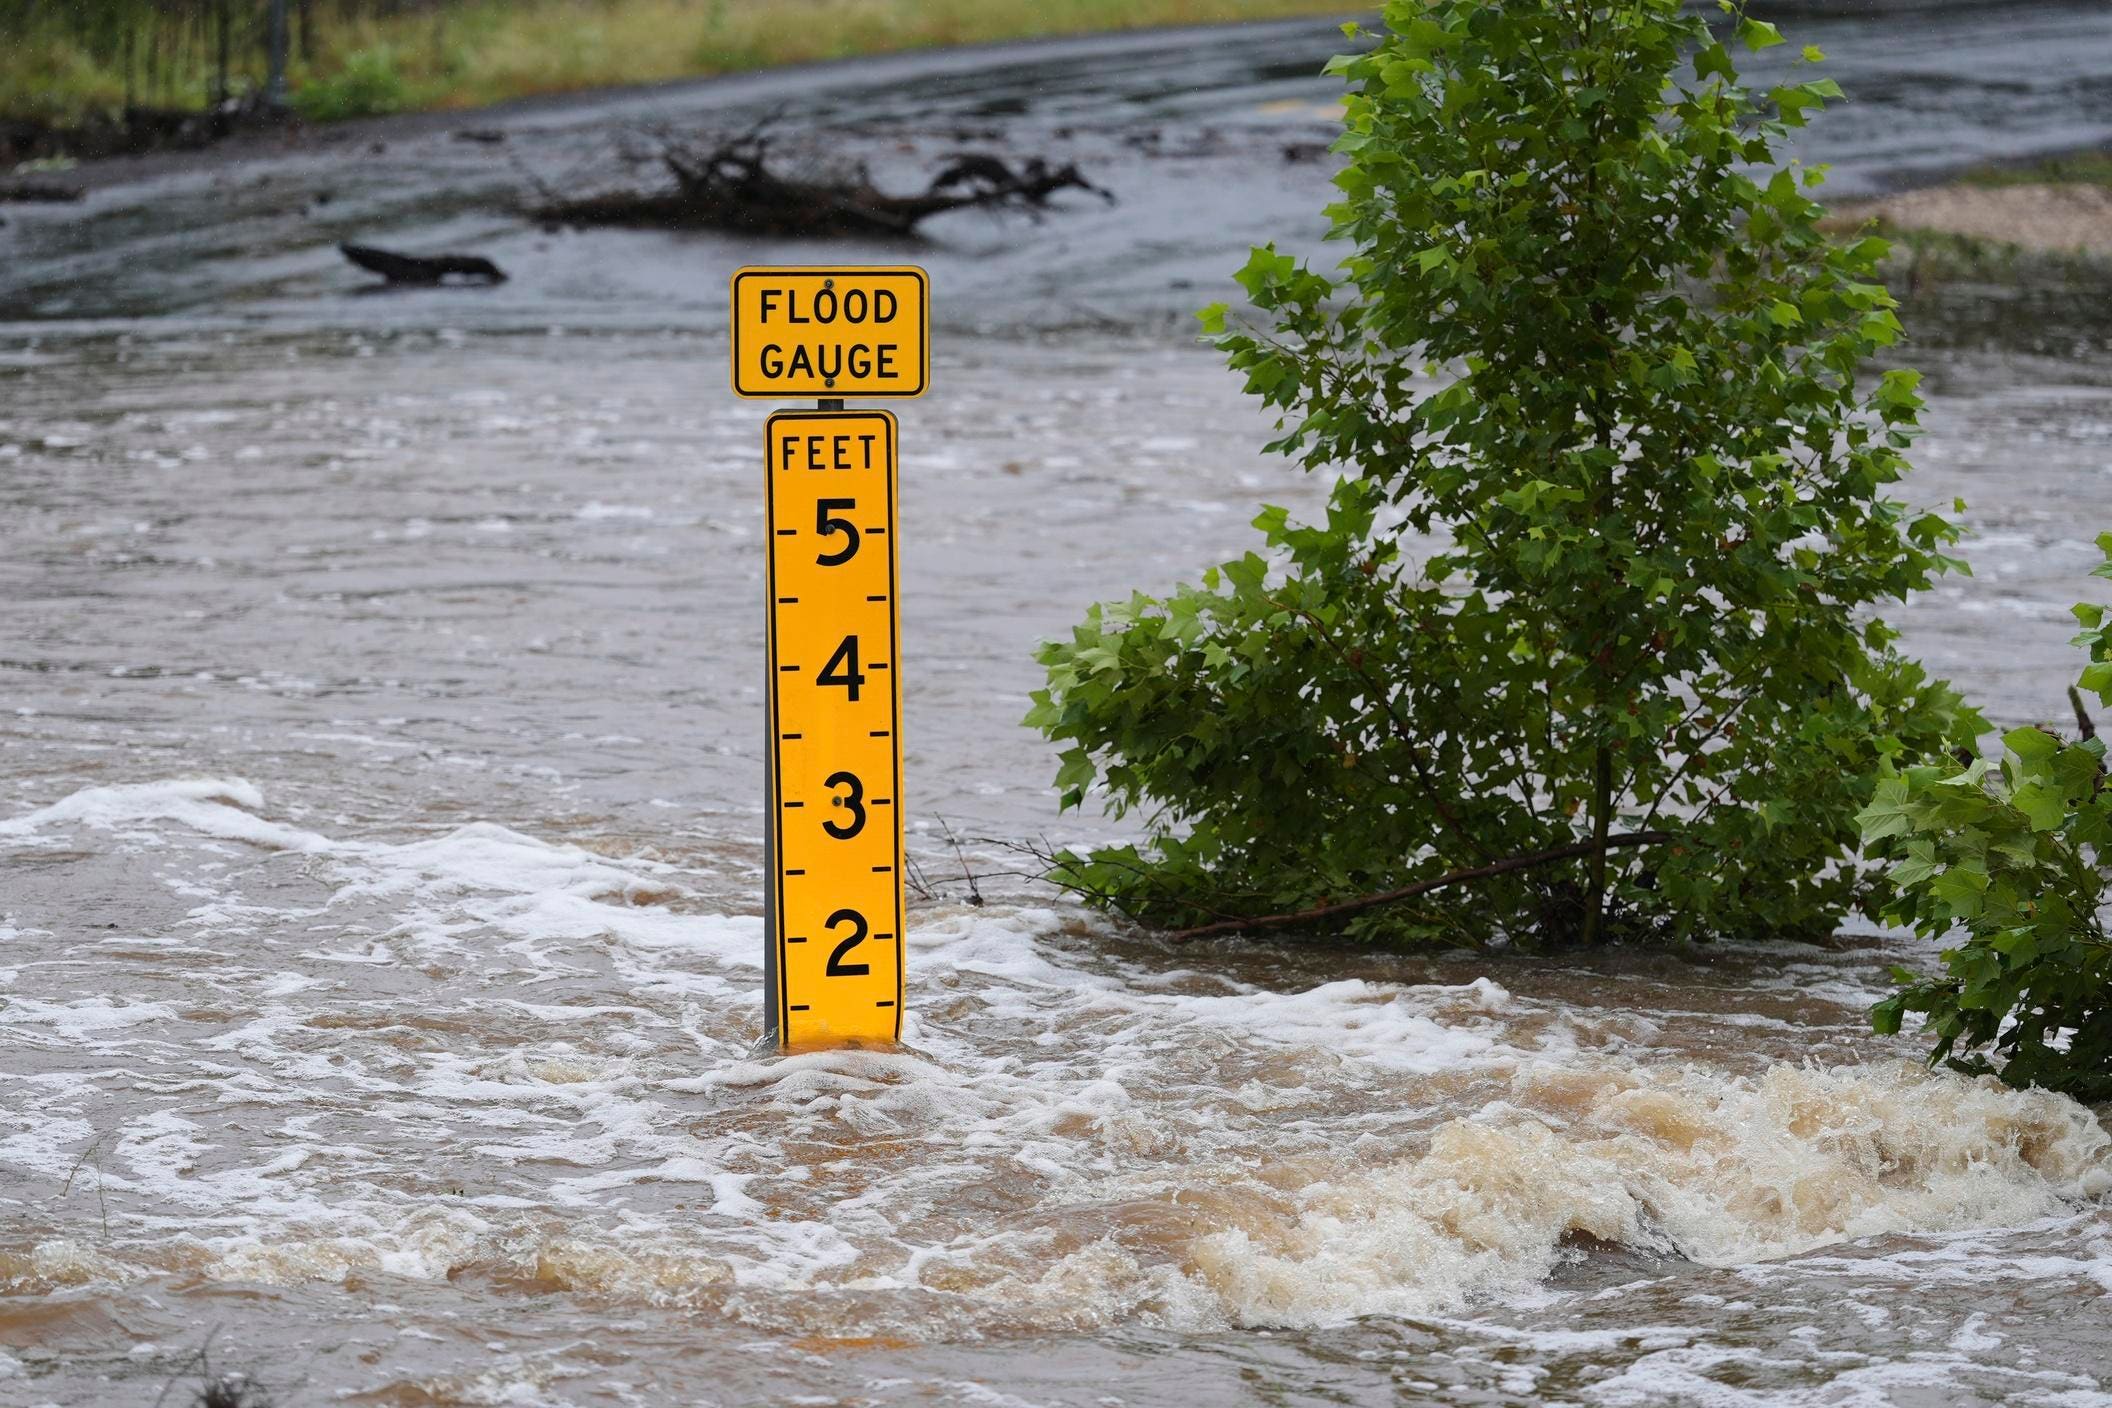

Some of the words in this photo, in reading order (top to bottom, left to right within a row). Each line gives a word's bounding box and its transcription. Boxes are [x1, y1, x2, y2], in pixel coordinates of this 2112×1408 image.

[760, 288, 898, 324] FLOOD
[760, 343, 899, 379] GAUGE
[781, 434, 876, 471] FEET
[815, 497, 861, 567] 5
[815, 634, 865, 702] 4
[821, 770, 867, 841] 3
[823, 908, 870, 977] 2
